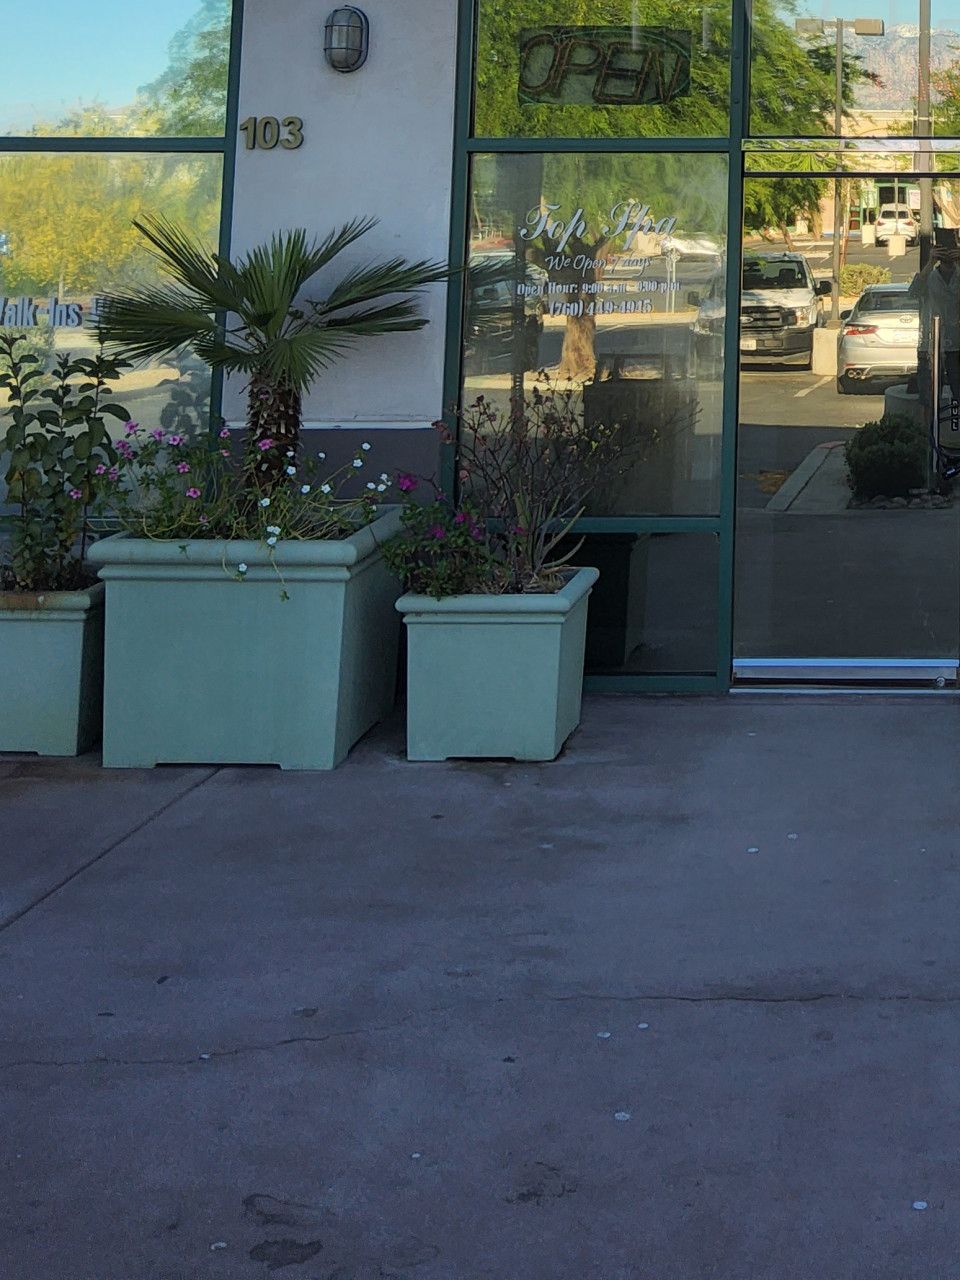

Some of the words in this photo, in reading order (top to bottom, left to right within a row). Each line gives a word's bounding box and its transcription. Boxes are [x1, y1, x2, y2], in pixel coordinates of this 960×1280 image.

[519, 32, 685, 105] OPEN
[240, 117, 304, 150] 103
[517, 204, 587, 252] Top
[602, 201, 678, 251] Spa
[545, 255, 571, 270] We
[573, 254, 608, 278] Open
[0, 297, 83, 328] alk-Ins
